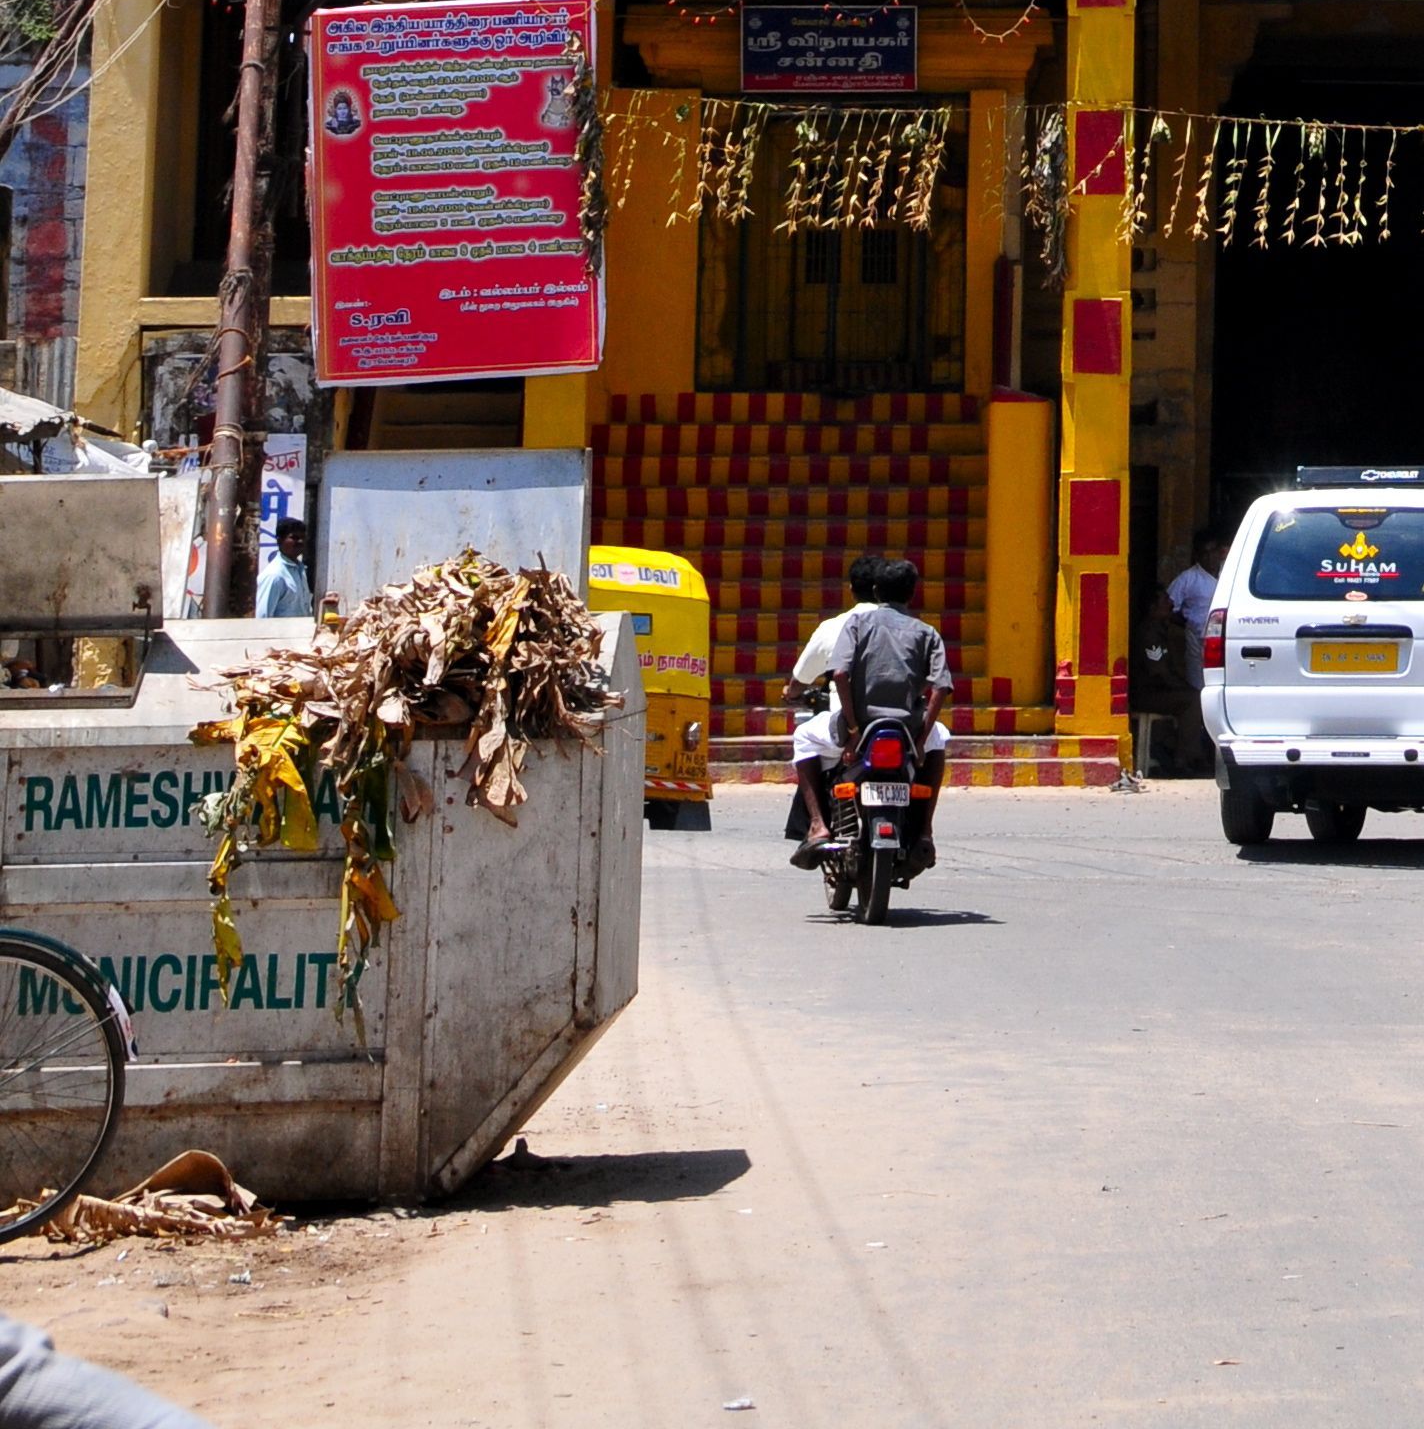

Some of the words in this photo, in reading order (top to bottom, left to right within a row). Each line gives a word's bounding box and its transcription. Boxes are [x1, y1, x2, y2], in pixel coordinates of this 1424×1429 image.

[327, 19, 368, 34] அகில
[370, 17, 420, 34] இந்திய
[423, 13, 490, 32] யாத்திரை
[327, 36, 363, 54] சங்க
[518, 27, 572, 49] அறிவிப்
[787, 31, 912, 52] விநாயகர்
[777, 51, 883, 72] சன்னதி
[638, 566, 678, 586] மலர்
[657, 651, 708, 678] நாளிதழ்
